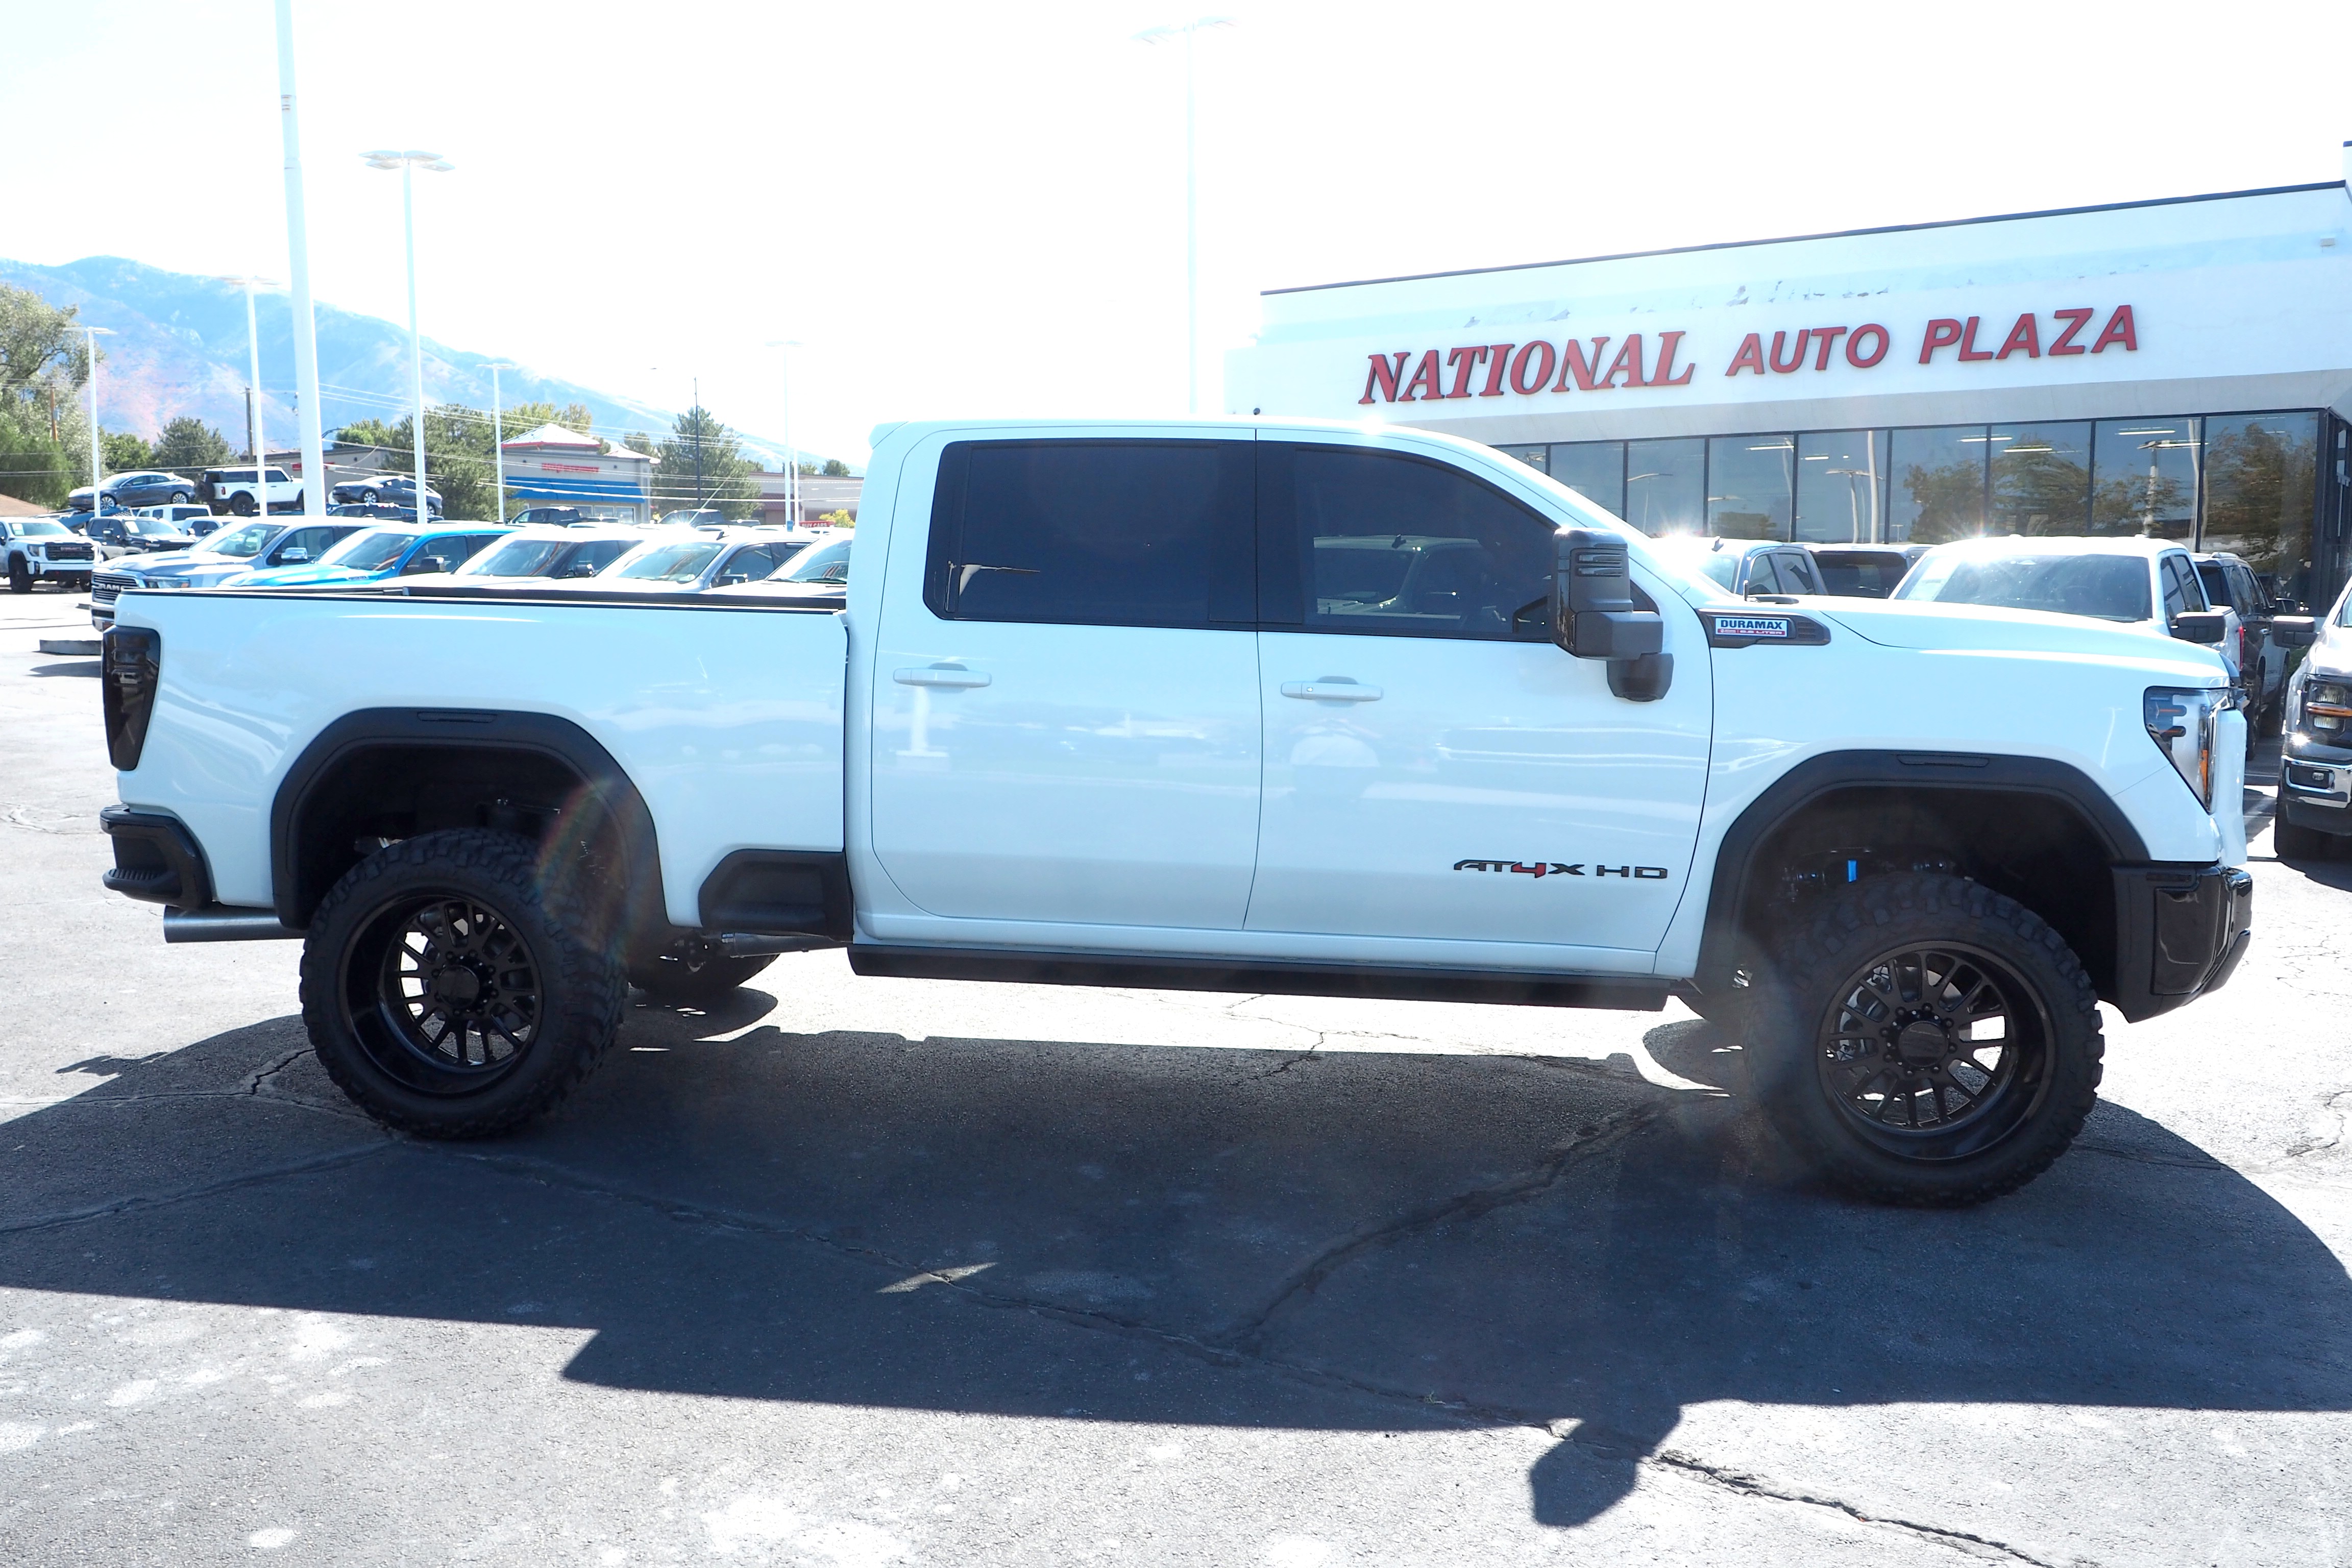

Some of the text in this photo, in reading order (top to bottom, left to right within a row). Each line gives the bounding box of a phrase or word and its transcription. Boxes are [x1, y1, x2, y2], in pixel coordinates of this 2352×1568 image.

[1358, 304, 2139, 405] NATIONAL AUTO PLAZA
[1721, 620, 1782, 629] DURAMAX
[1453, 859, 1668, 879] AT4X HD
